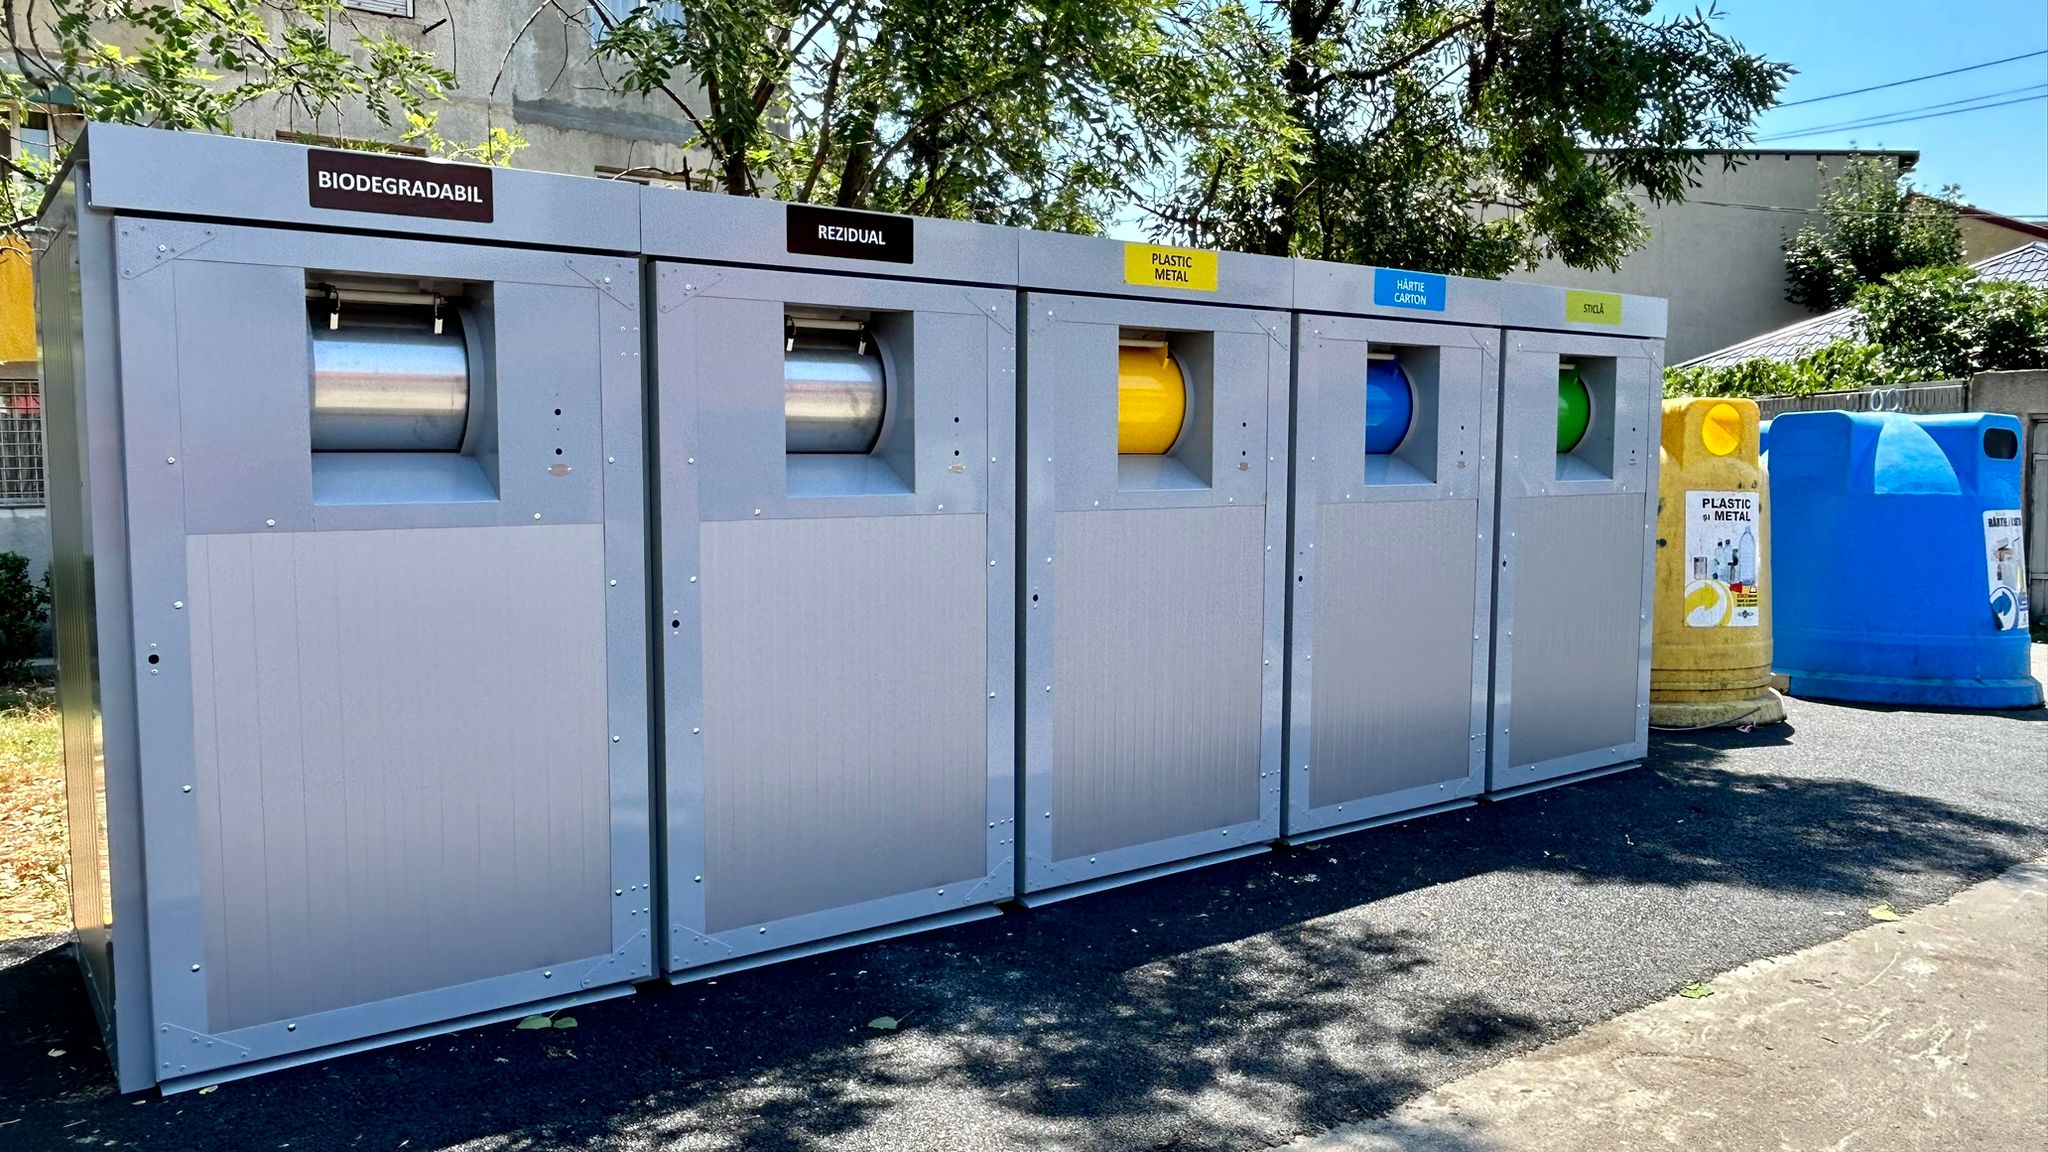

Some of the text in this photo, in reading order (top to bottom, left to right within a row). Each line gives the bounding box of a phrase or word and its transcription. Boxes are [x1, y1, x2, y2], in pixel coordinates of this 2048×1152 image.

[318, 170, 483, 203] BIODEGRADABIL
[818, 224, 886, 245] REZIDUAL
[1152, 253, 1192, 268] PLASTIC
[1155, 268, 1189, 282] METAL
[1394, 292, 1427, 305] CARTON
[1702, 498, 1751, 509] PLASTIC
[1715, 511, 1751, 521] METAL
